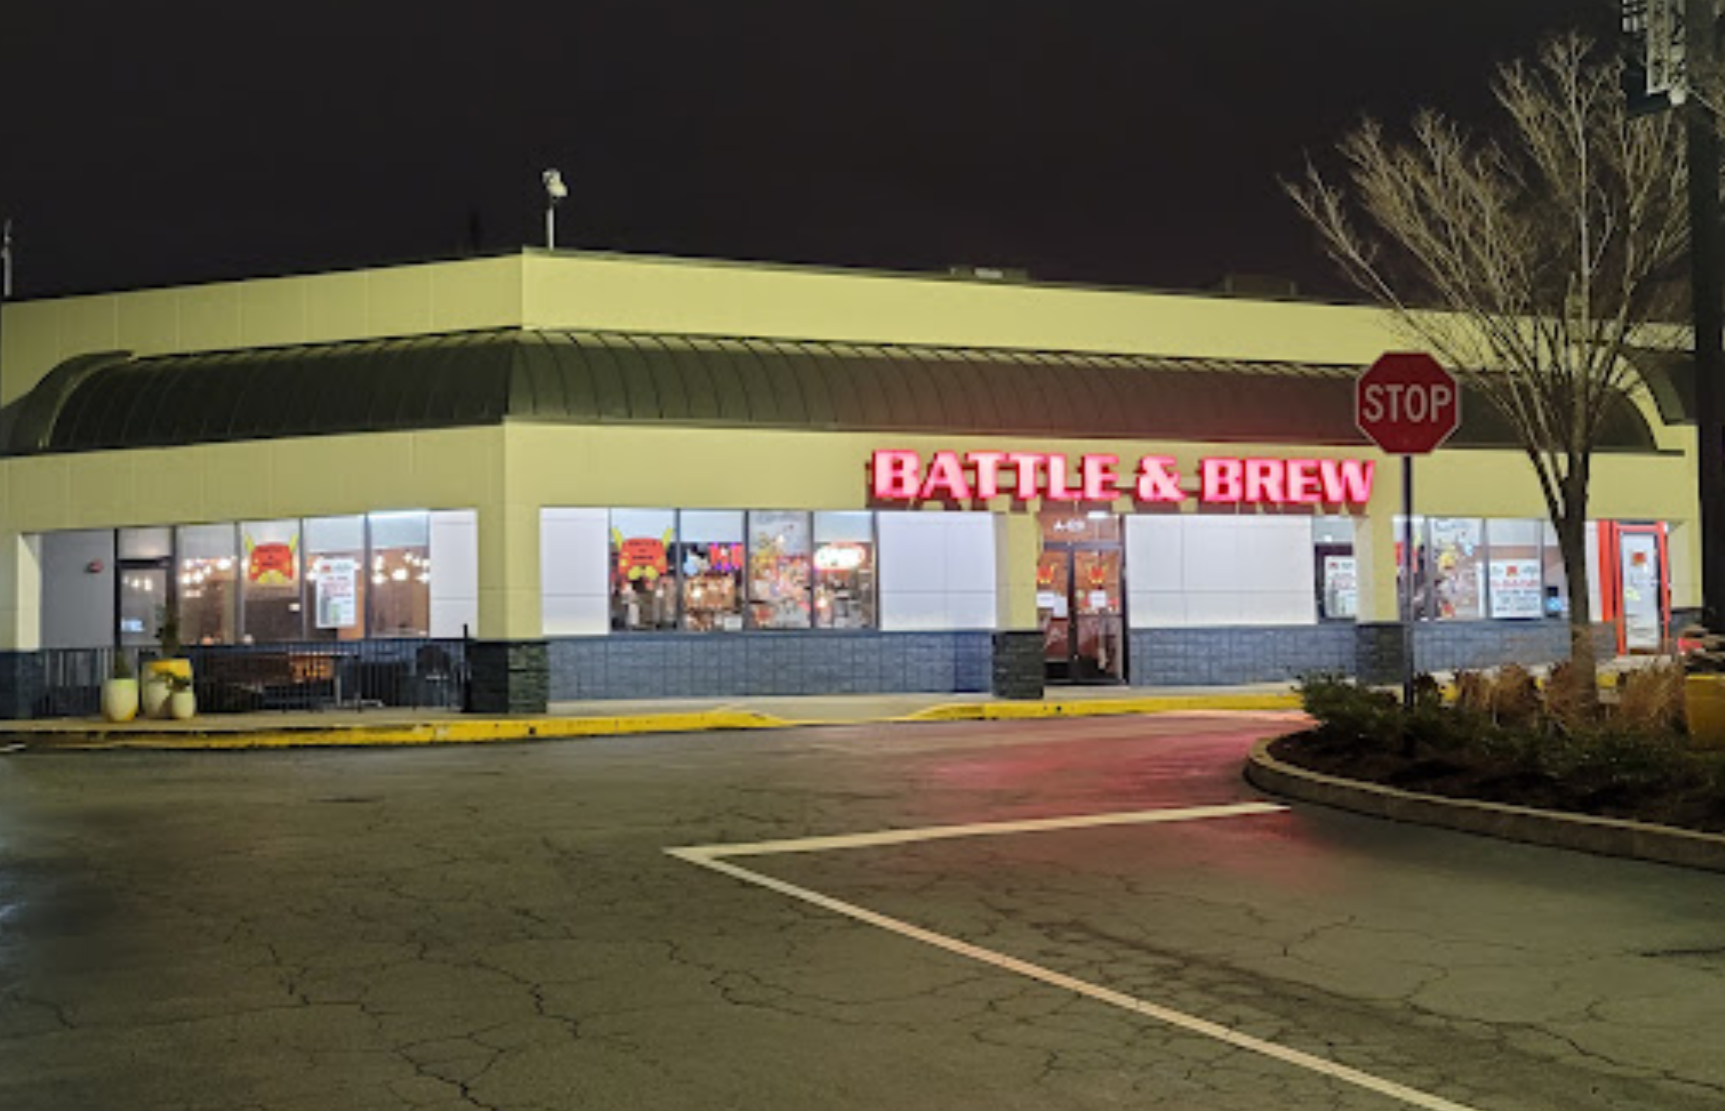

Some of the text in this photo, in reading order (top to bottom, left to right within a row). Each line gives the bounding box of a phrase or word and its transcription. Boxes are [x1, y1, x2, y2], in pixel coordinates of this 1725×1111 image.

[1362, 383, 1453, 423] STOP
[872, 449, 1376, 504] BATTLE & BREW
